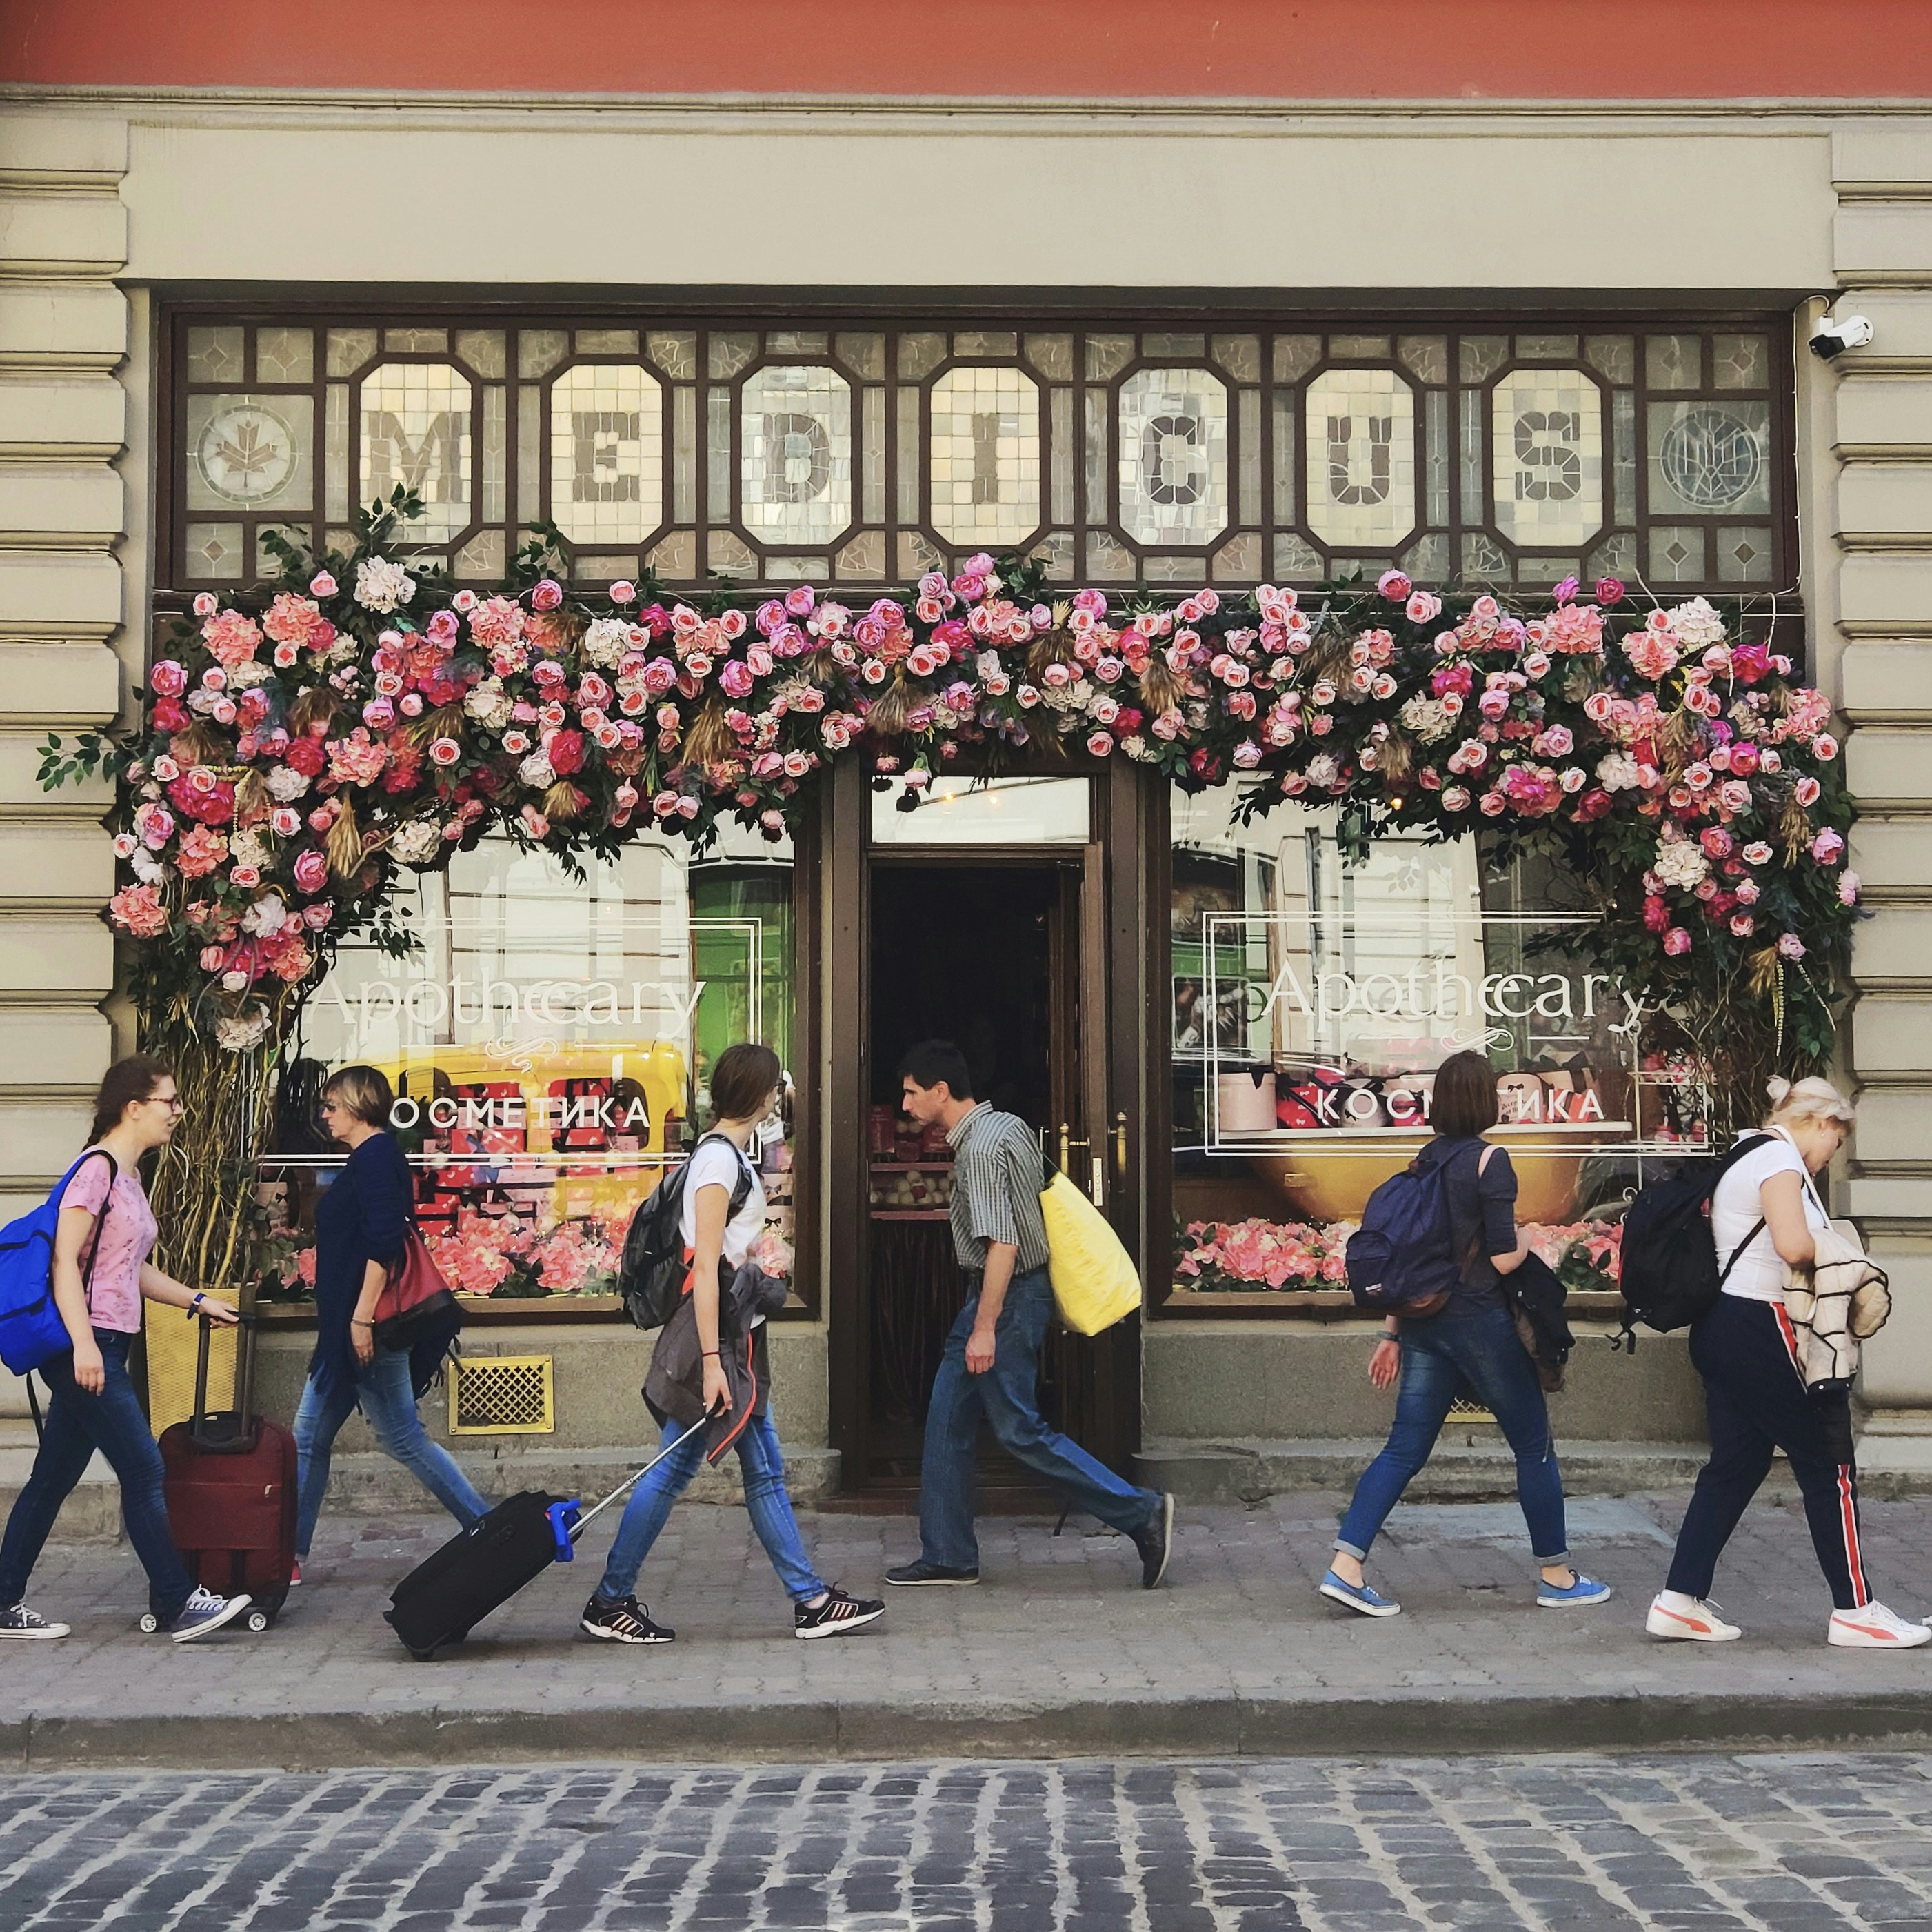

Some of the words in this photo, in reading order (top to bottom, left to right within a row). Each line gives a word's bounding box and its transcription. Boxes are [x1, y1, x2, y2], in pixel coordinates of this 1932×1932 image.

[368, 411, 1582, 505] MEDICUS
[305, 966, 707, 1038] Apothecary
[1261, 959, 1651, 1034] Apothecary
[389, 1097, 650, 1129] ОСМЕТИКА
[1317, 1089, 1605, 1120] КОСИКА
